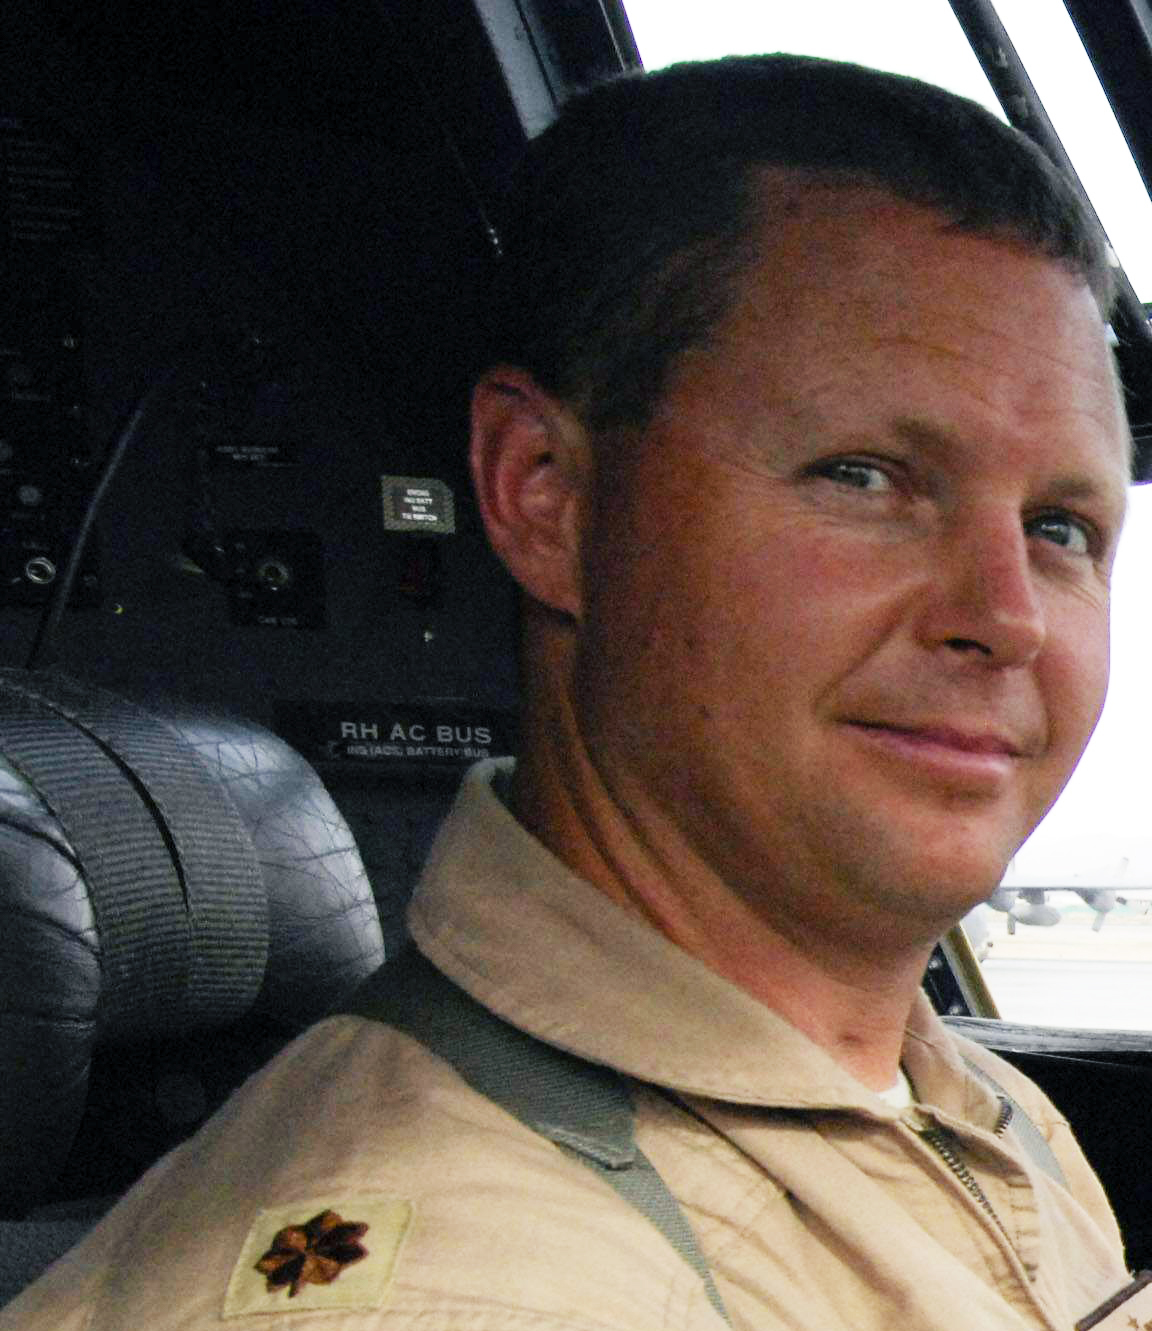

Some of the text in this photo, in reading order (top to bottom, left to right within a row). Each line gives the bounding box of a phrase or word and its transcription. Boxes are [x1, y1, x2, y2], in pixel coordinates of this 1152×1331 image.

[340, 721, 493, 744] RH AC BUS
